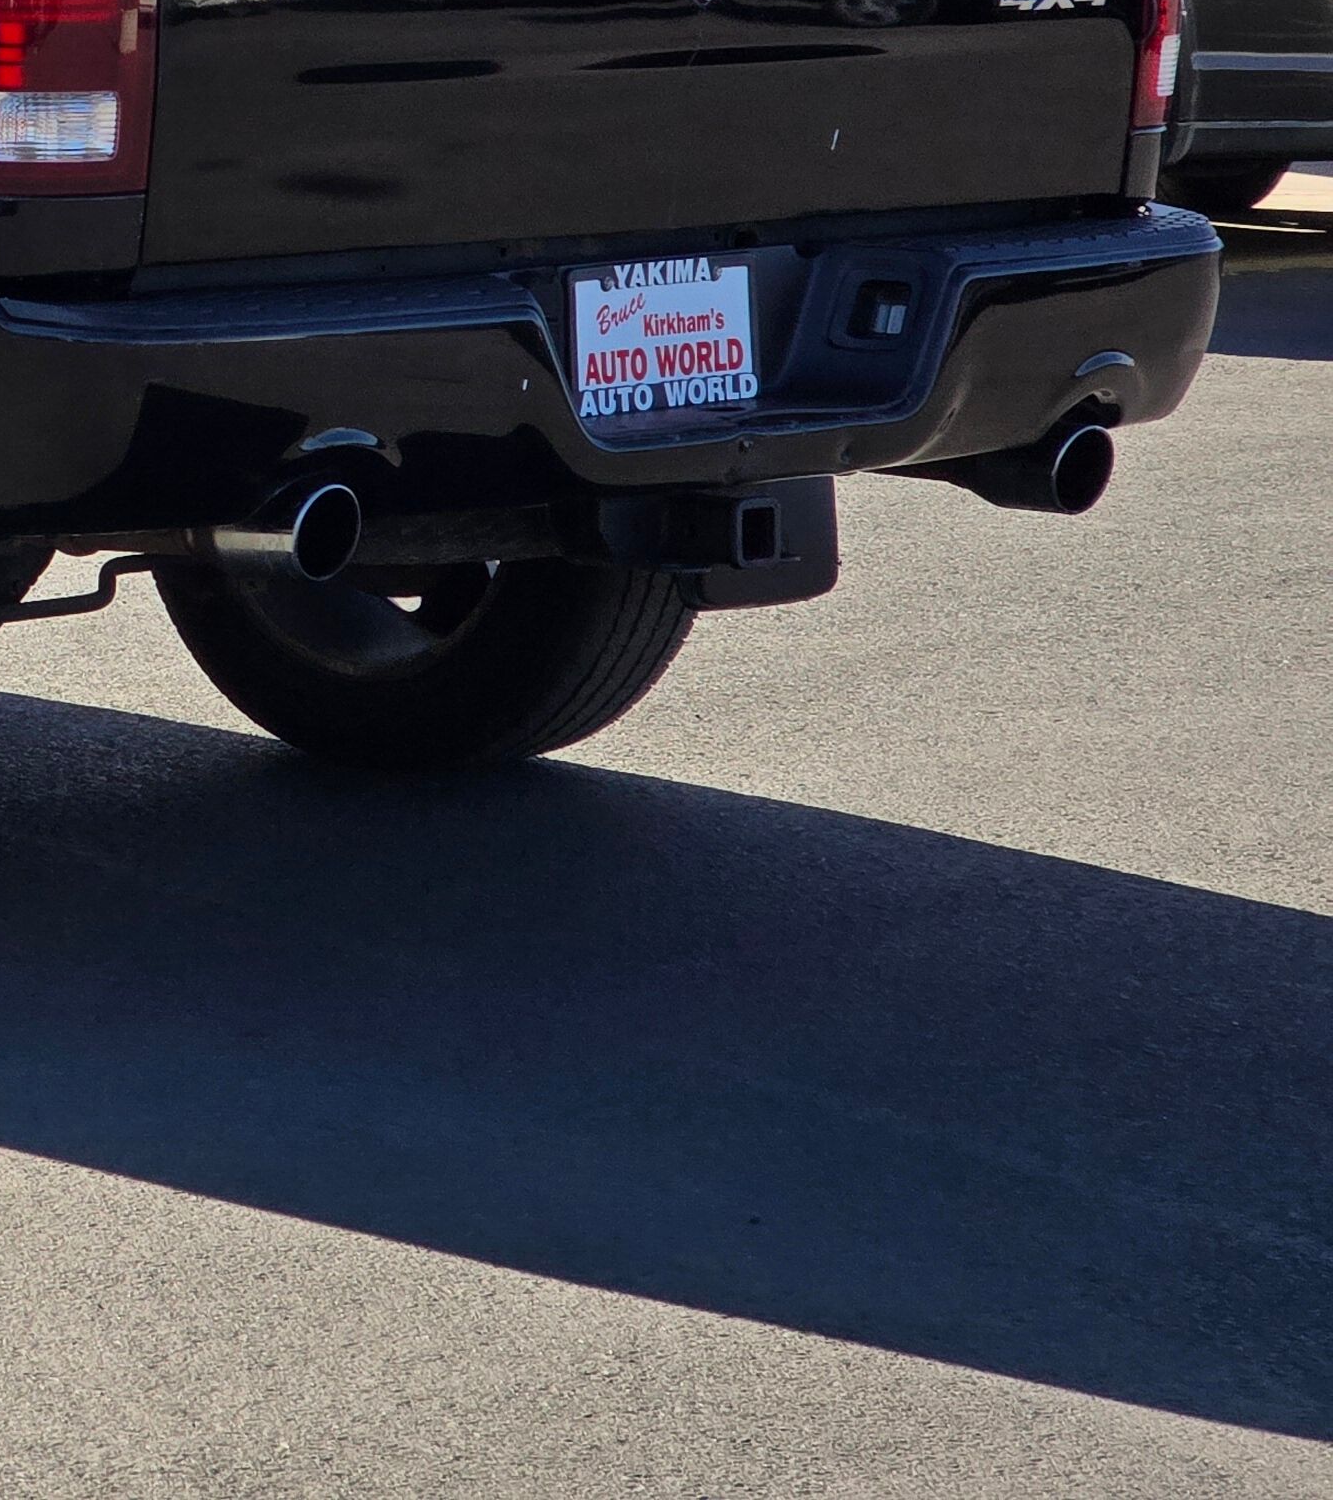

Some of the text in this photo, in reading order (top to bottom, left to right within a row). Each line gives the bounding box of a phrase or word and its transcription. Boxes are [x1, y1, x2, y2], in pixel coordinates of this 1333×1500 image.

[614, 257, 711, 289] YAKIMA
[596, 293, 645, 335] Bruce
[643, 308, 725, 337] Kirkham's
[585, 338, 744, 386] AUTO WORLD
[580, 373, 758, 417] AUTO WORLD
